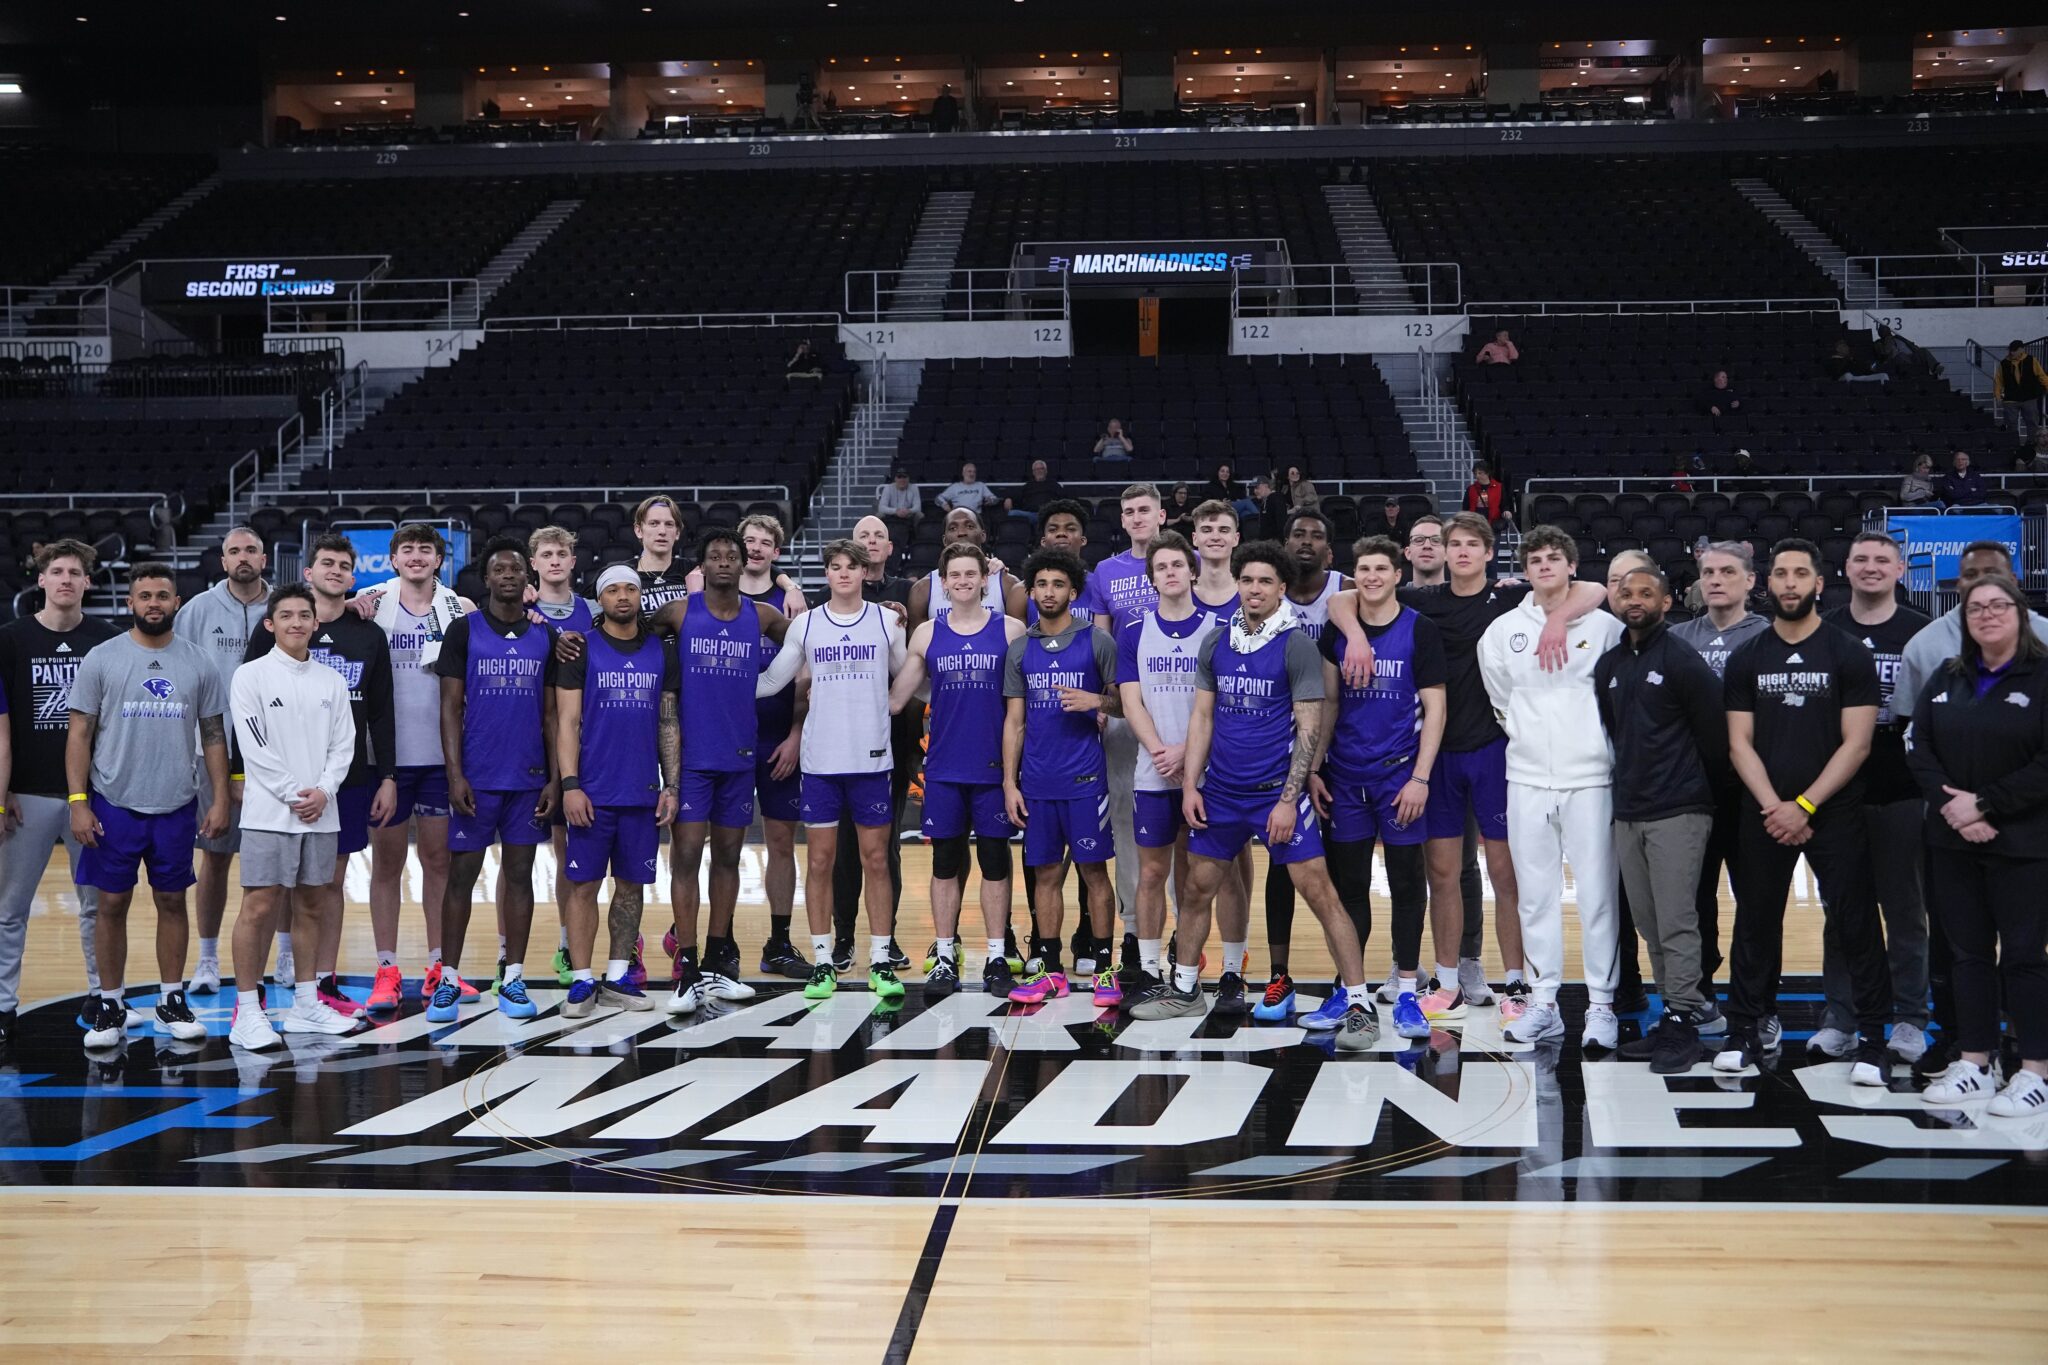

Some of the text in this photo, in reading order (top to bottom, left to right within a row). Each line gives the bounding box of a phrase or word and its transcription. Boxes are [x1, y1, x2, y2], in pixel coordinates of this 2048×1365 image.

[1907, 120, 1930, 132] 233
[1114, 136, 1138, 148] 231
[1500, 129, 1524, 141] 232
[748, 143, 771, 156] 230
[376, 152, 399, 165] 229
[225, 264, 296, 280] FIRST AND
[185, 279, 336, 297] SECOND ROUNDS
[1033, 328, 1062, 342] 122
[1240, 325, 1270, 339] 122
[1404, 323, 1434, 337] 123
[865, 331, 895, 344] 121
[425, 338, 453, 352] 121
[1110, 575, 1138, 594] HIGH
[1112, 587, 1158, 602] UNIVERS
[217, 637, 241, 648] HIGH
[390, 634, 416, 650] HIGH
[690, 637, 752, 659] HIGH POINT
[814, 644, 877, 663] HIGH POINT
[477, 658, 541, 676] HIGH POINT
[937, 653, 999, 673] HIGH POINT
[1147, 656, 1198, 673] HIGH POIN
[1374, 659, 1405, 678] OINT
[690, 666, 749, 679] BASKETBALL
[817, 673, 876, 683] BASKETBALL
[1757, 672, 1789, 687] HIGH
[1790, 671, 1829, 688] POINT
[597, 671, 658, 690] HIGH POINT
[940, 682, 996, 691] BASKETBALL
[1026, 671, 1085, 690] HIGH POINT
[1216, 675, 1275, 697] HIGH POINT
[480, 687, 535, 697] BASKETBAL
